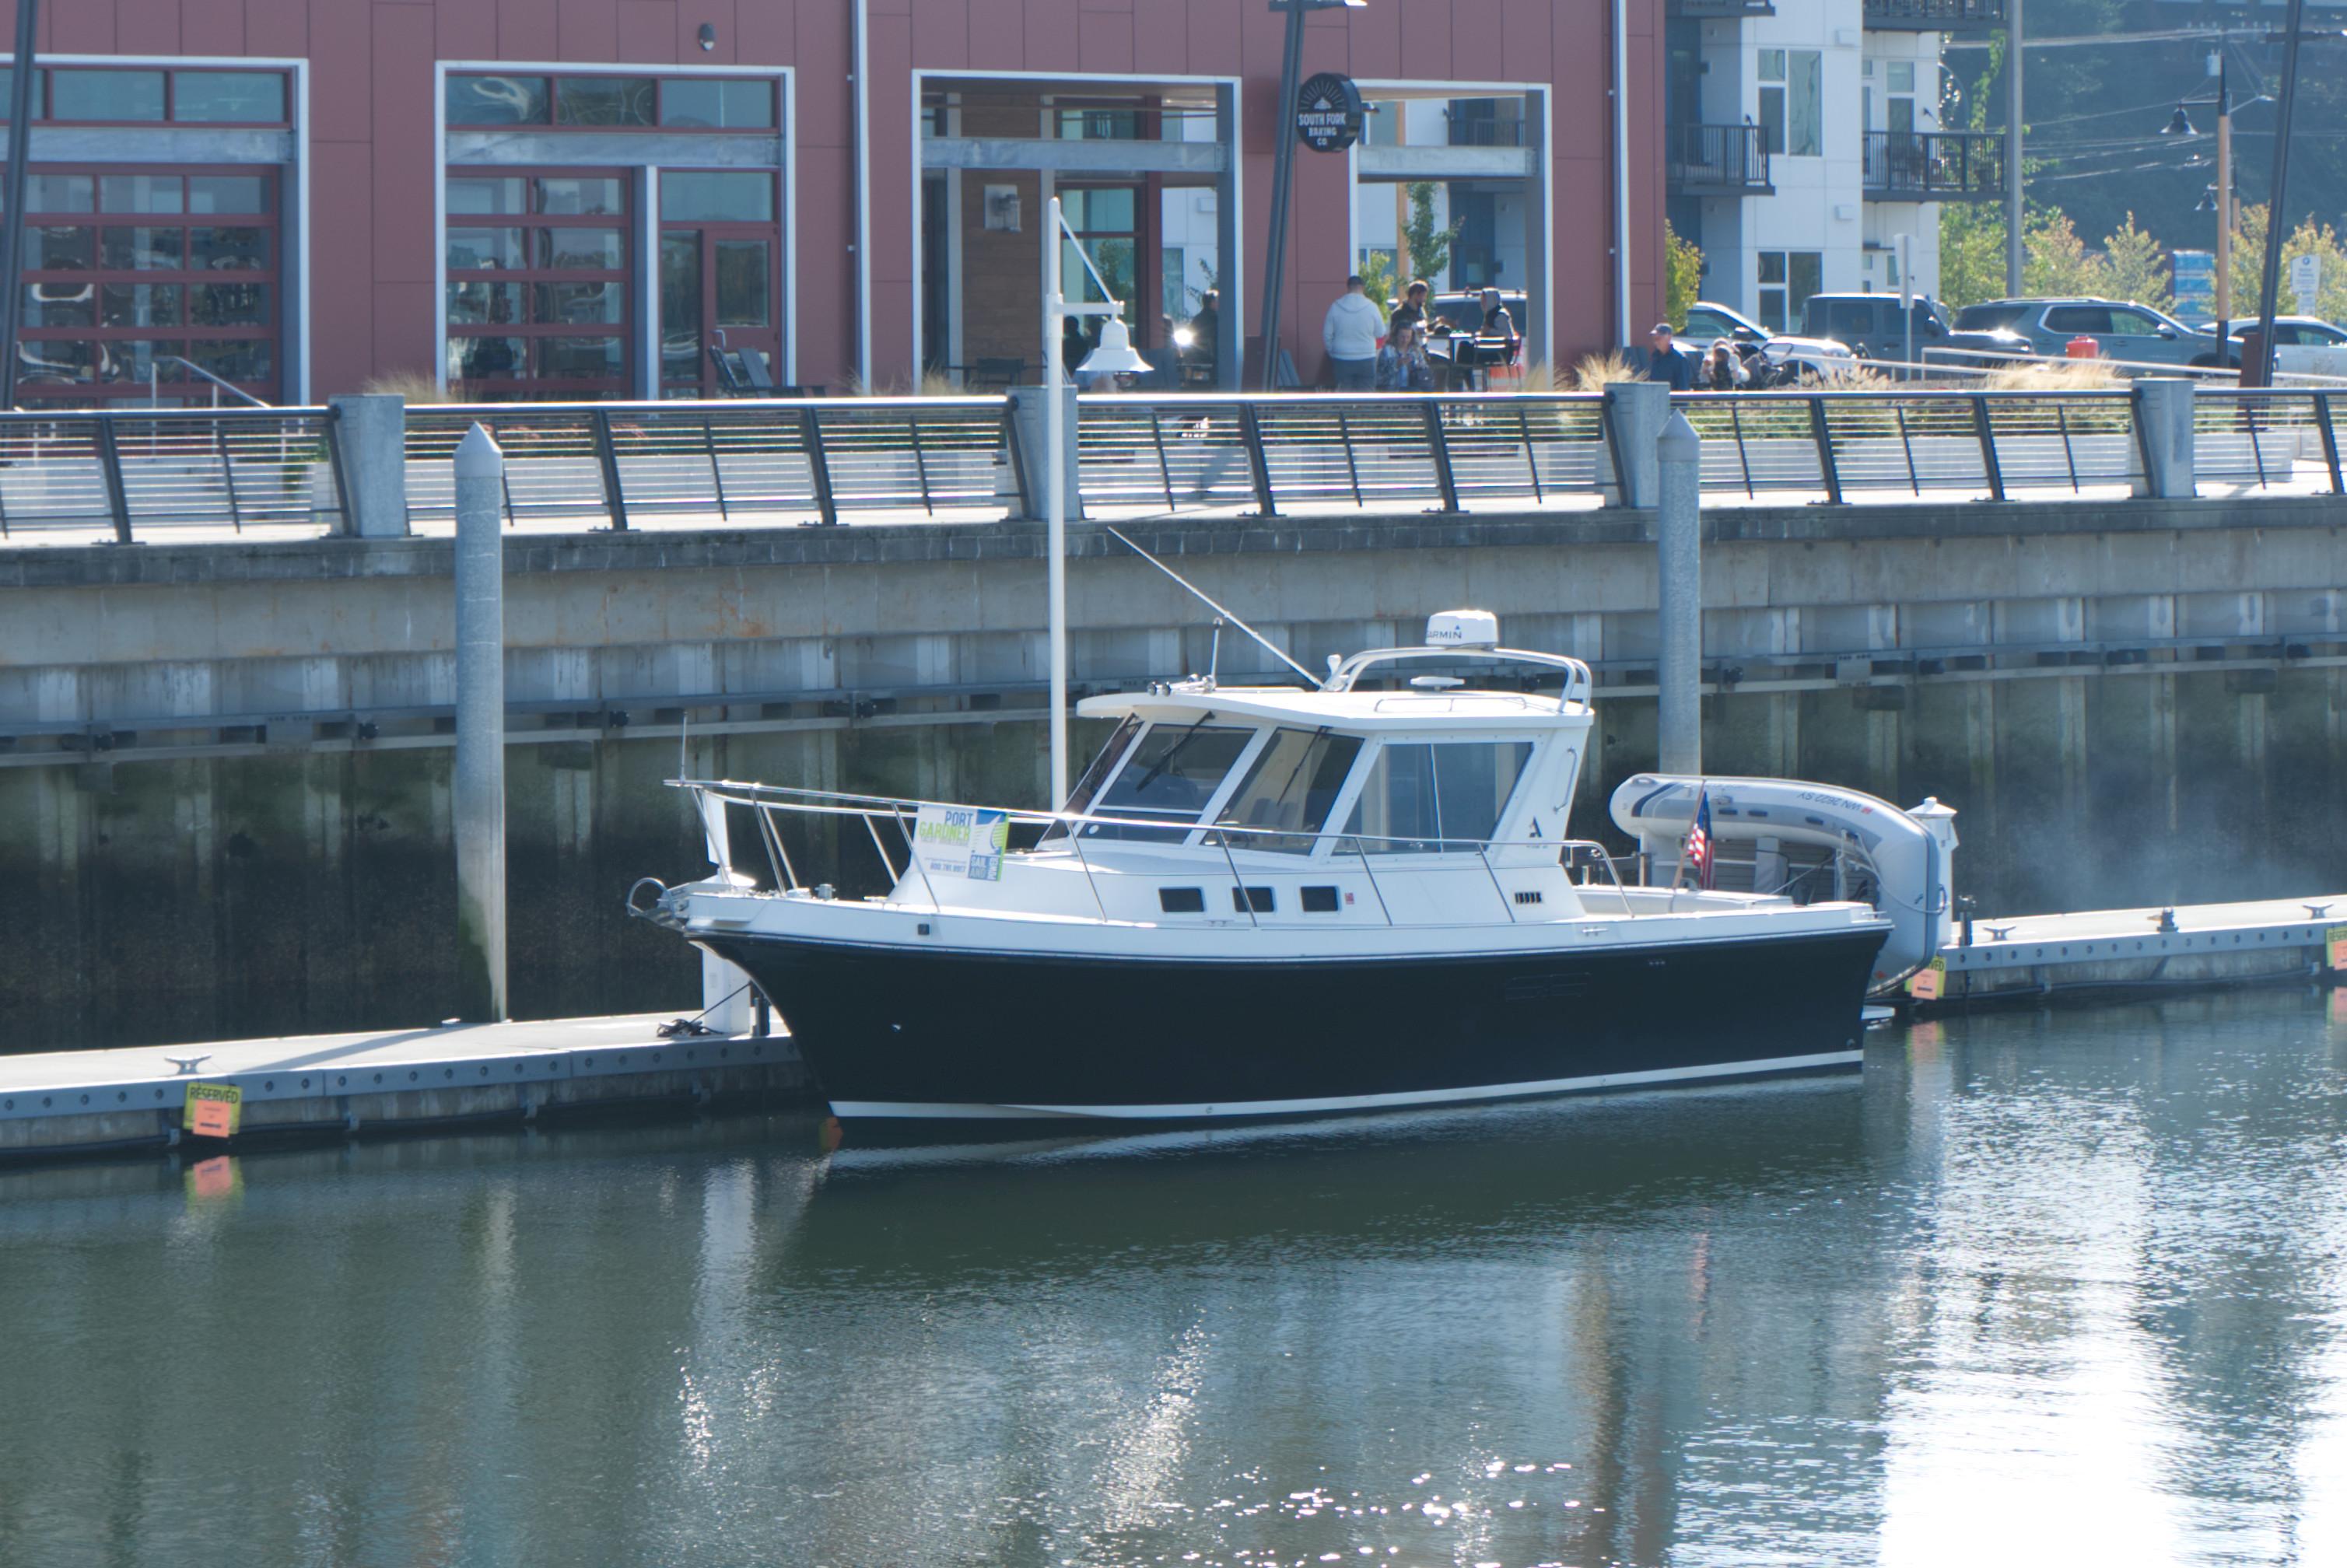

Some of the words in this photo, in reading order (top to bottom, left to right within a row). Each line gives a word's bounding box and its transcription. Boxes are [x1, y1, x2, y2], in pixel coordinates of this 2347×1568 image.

[1298, 113, 1325, 126] SOUTH
[1326, 113, 1346, 125] FORK
[1308, 127, 1337, 137] BAKING
[944, 810, 973, 827] PORT
[919, 821, 971, 841] GARDNER
[191, 1087, 239, 1104] RESERVED
